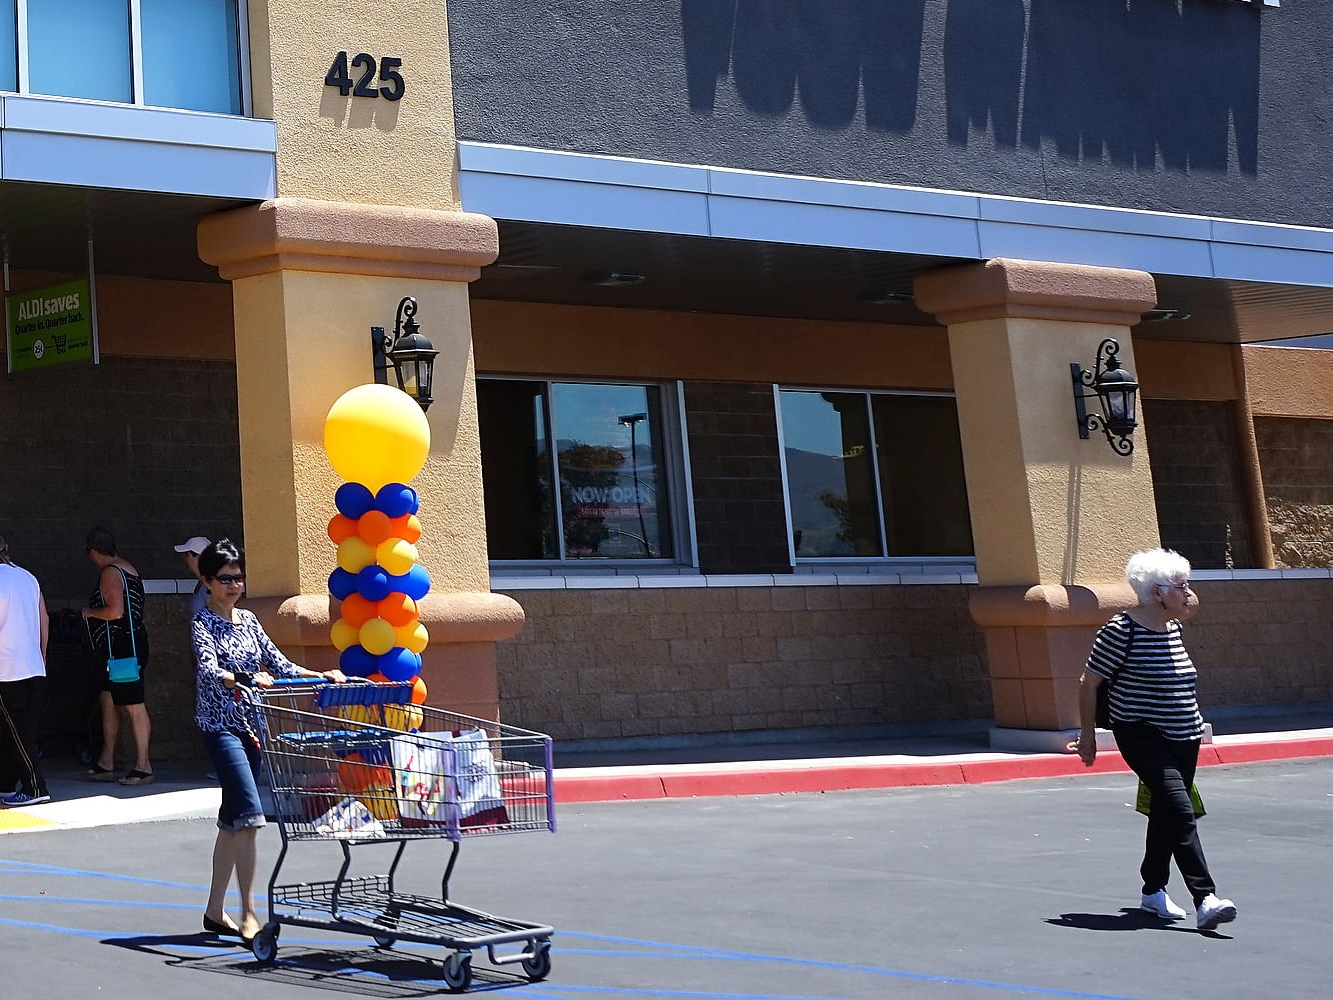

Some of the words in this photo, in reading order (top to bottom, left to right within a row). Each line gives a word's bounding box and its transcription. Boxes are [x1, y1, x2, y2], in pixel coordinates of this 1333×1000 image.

[325, 51, 406, 101] 425
[18, 297, 44, 321] ALDI
[44, 293, 80, 315] saves
[571, 486, 609, 504] NOW
[612, 486, 653, 504] OPEN
